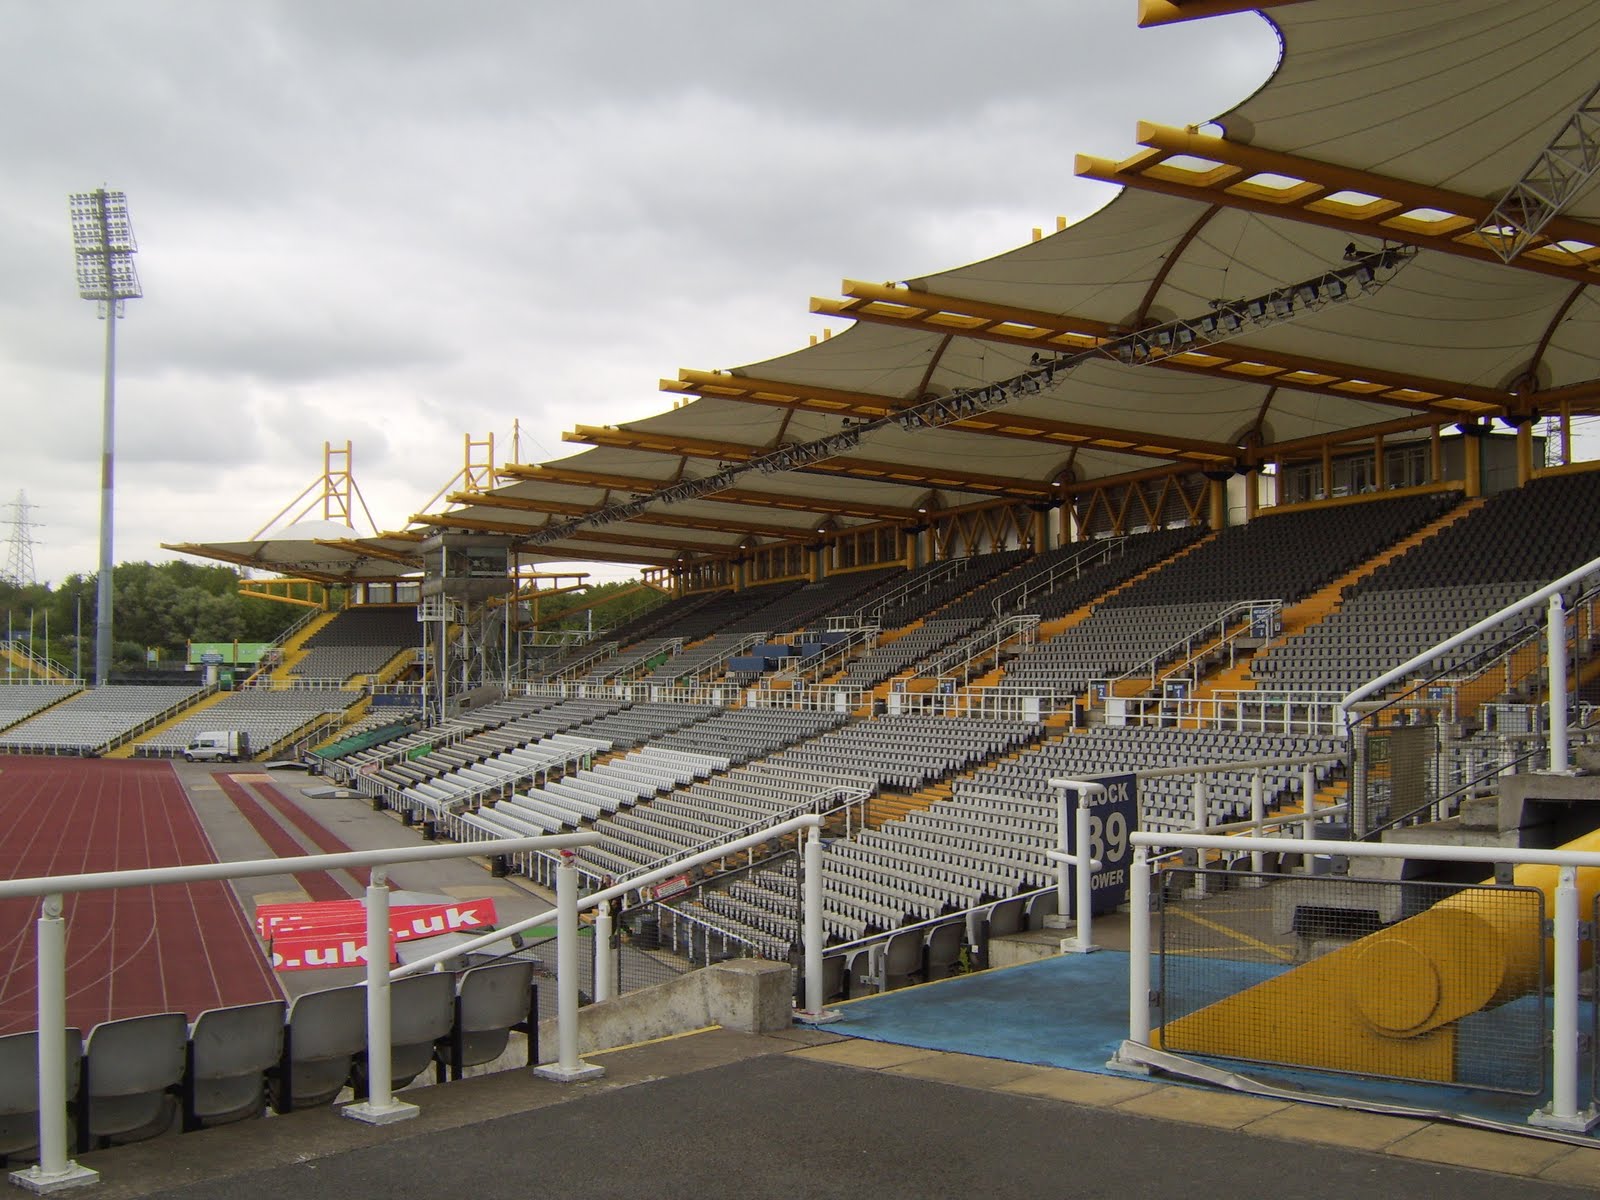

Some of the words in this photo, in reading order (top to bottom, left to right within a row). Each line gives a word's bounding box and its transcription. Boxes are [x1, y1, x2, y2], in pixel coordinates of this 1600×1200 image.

[1088, 782, 1129, 807] LOCK
[1090, 869, 1125, 891] OWER
[389, 907, 481, 938] .uk
